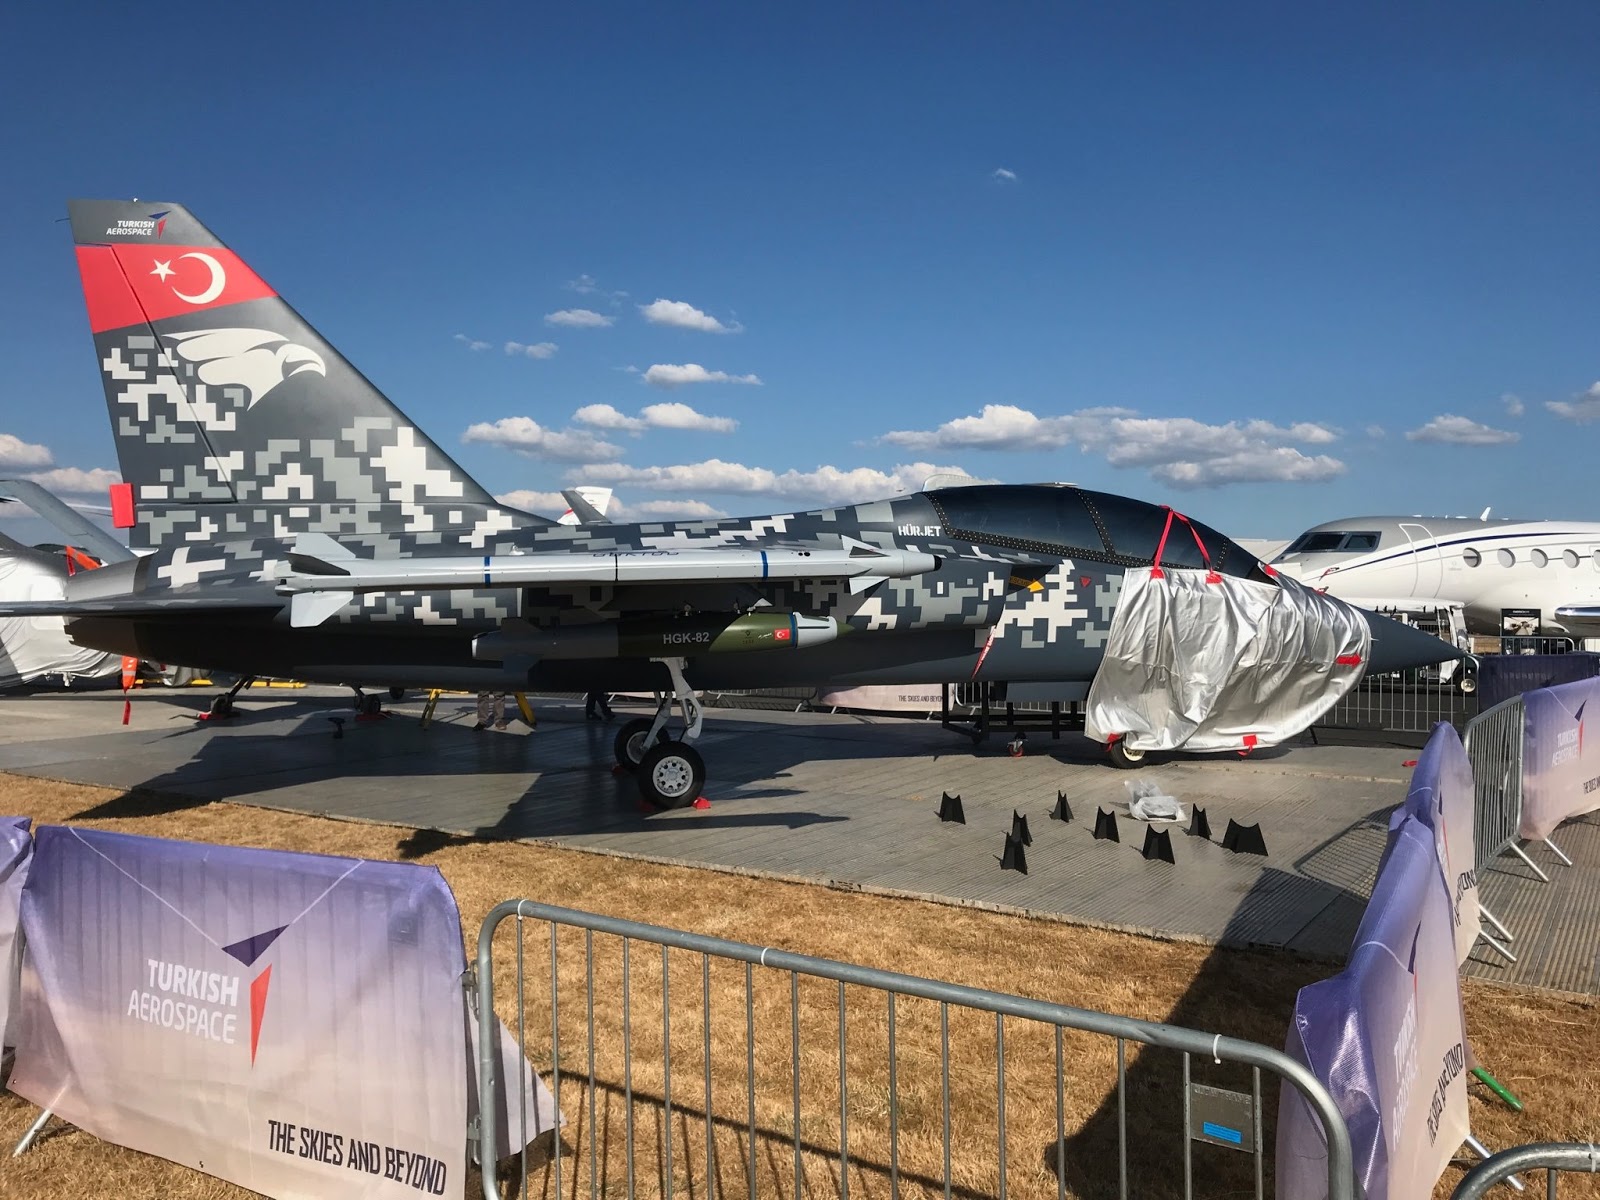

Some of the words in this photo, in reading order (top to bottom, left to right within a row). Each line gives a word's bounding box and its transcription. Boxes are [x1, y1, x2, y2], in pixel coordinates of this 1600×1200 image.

[117, 220, 155, 228] TURKISH
[105, 228, 153, 236] AEROSPACE
[898, 523, 942, 537] HÜRJET
[663, 632, 710, 645] HGK-82
[148, 958, 240, 1007] TURKISH
[127, 988, 237, 1045] AEROSPACE
[268, 1119, 297, 1156] THE
[299, 1126, 344, 1167] SKIES
[347, 1139, 381, 1176] AND
[384, 1146, 447, 1196] BEYOND
